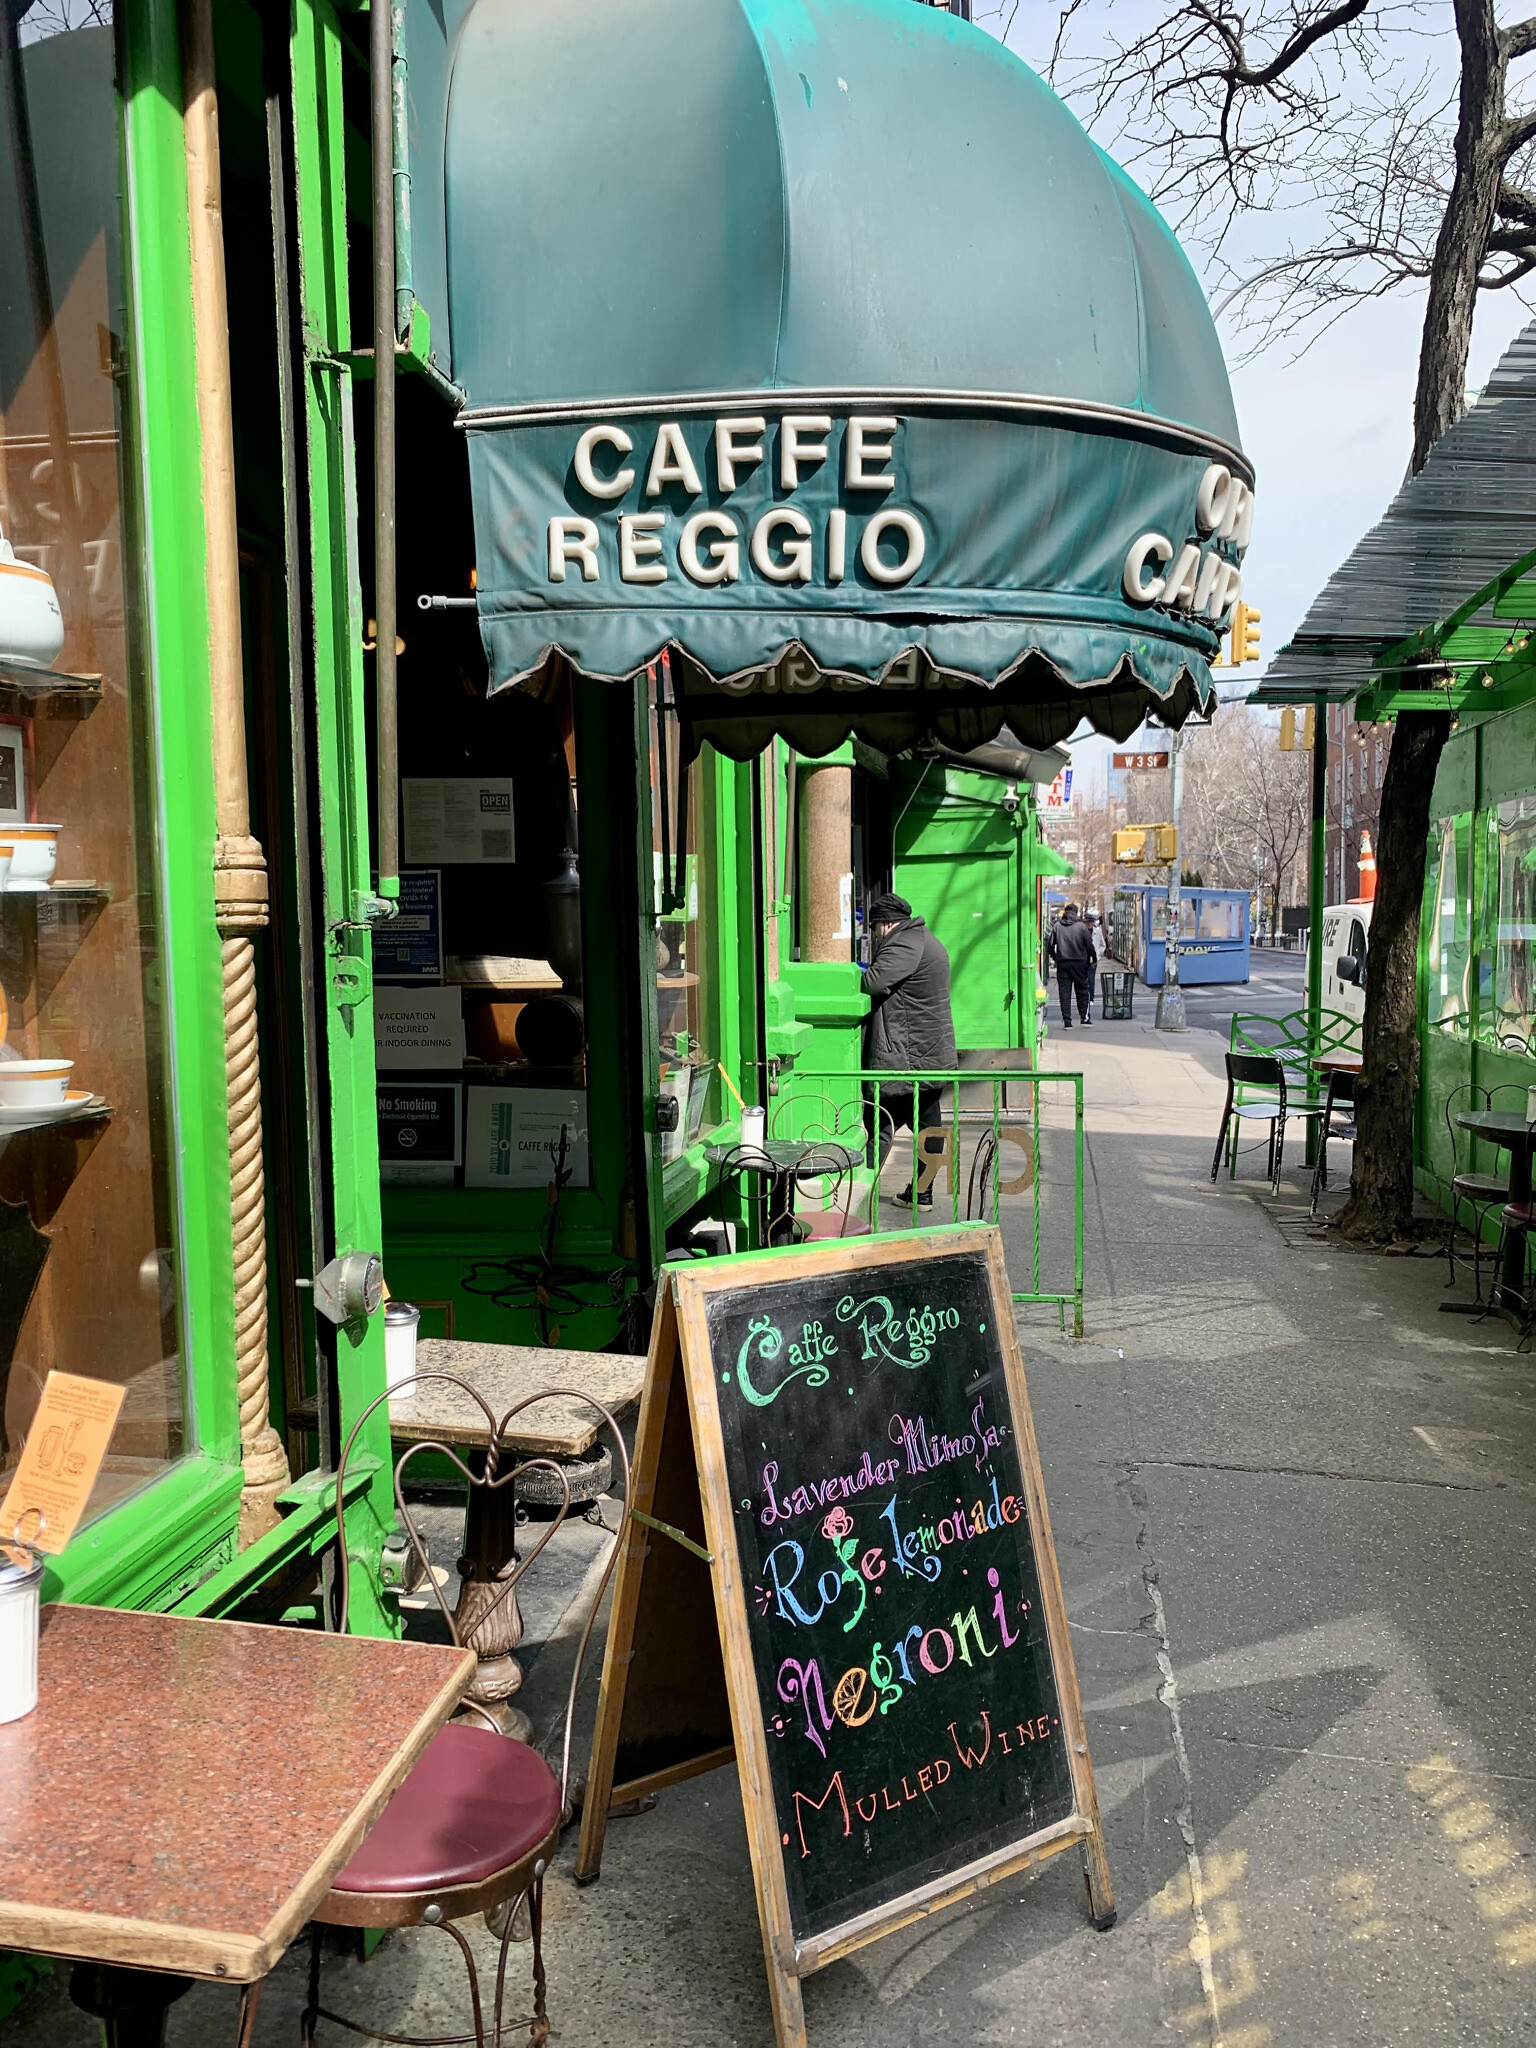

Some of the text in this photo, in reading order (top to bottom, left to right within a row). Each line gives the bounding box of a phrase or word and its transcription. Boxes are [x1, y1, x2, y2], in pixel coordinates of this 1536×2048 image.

[573, 415, 898, 499] CAFFE
[548, 508, 926, 584] REGGIO
[1125, 756, 1157, 767] W 3 St
[481, 795, 508, 806] OPEN
[386, 1025, 429, 1033] REQUIRED
[421, 1039, 451, 1047] DINING
[378, 1098, 437, 1112] No Smoking
[406, 1113, 430, 1121] Cigarette
[518, 1140, 541, 1151] CAFFE
[737, 1295, 960, 1407] Caffe Reggio
[760, 1451, 900, 1526] Lavender
[879, 1475, 1020, 1581] Lemonade
[777, 1566, 1020, 1759] Negroni
